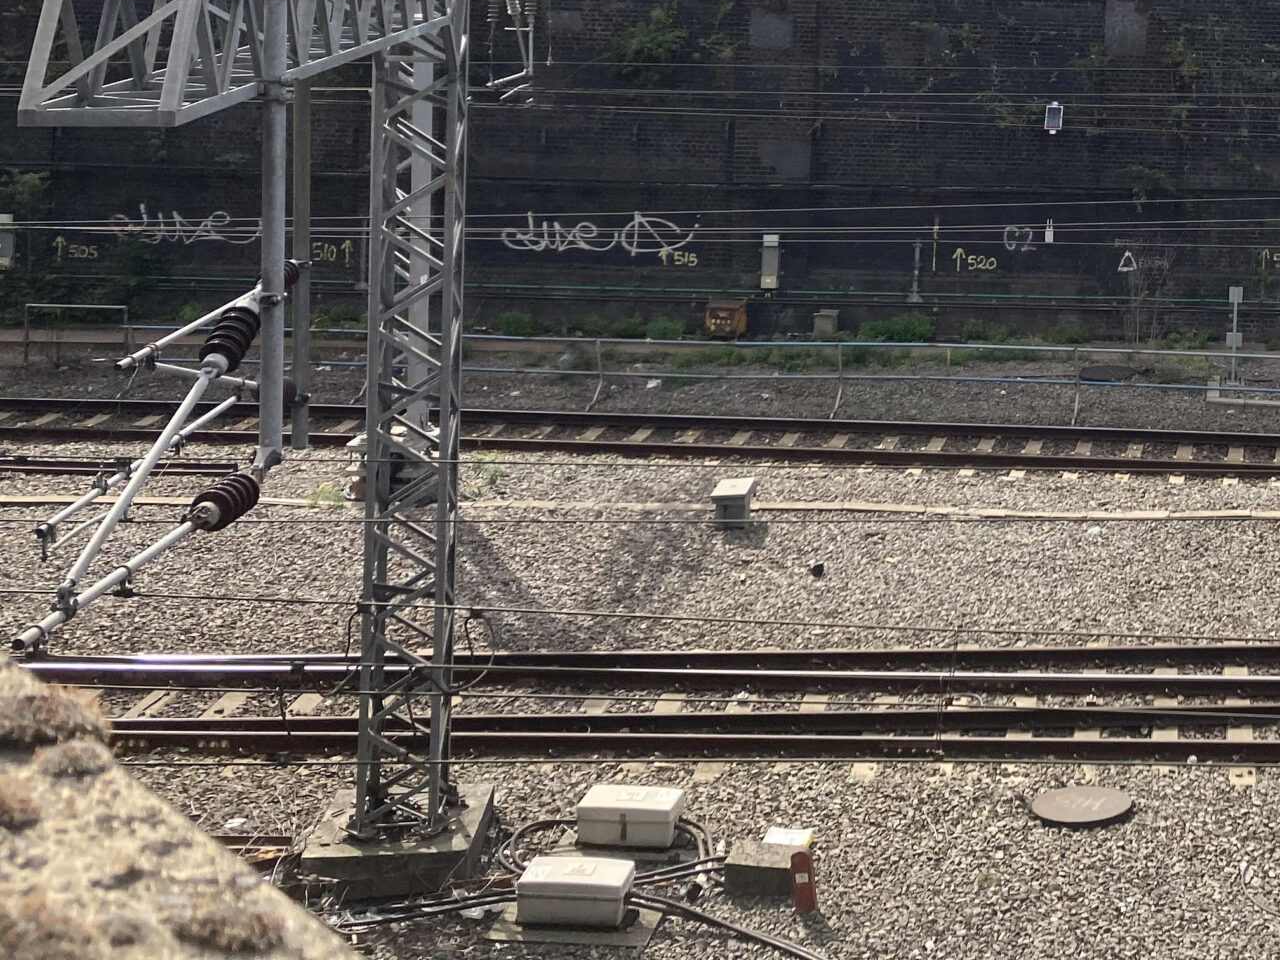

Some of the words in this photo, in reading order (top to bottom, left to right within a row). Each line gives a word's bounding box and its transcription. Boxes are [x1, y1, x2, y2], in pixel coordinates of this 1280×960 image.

[68, 244, 98, 259] 505
[312, 244, 337, 261] 510
[673, 251, 698, 266] 515
[967, 254, 997, 271] 520
